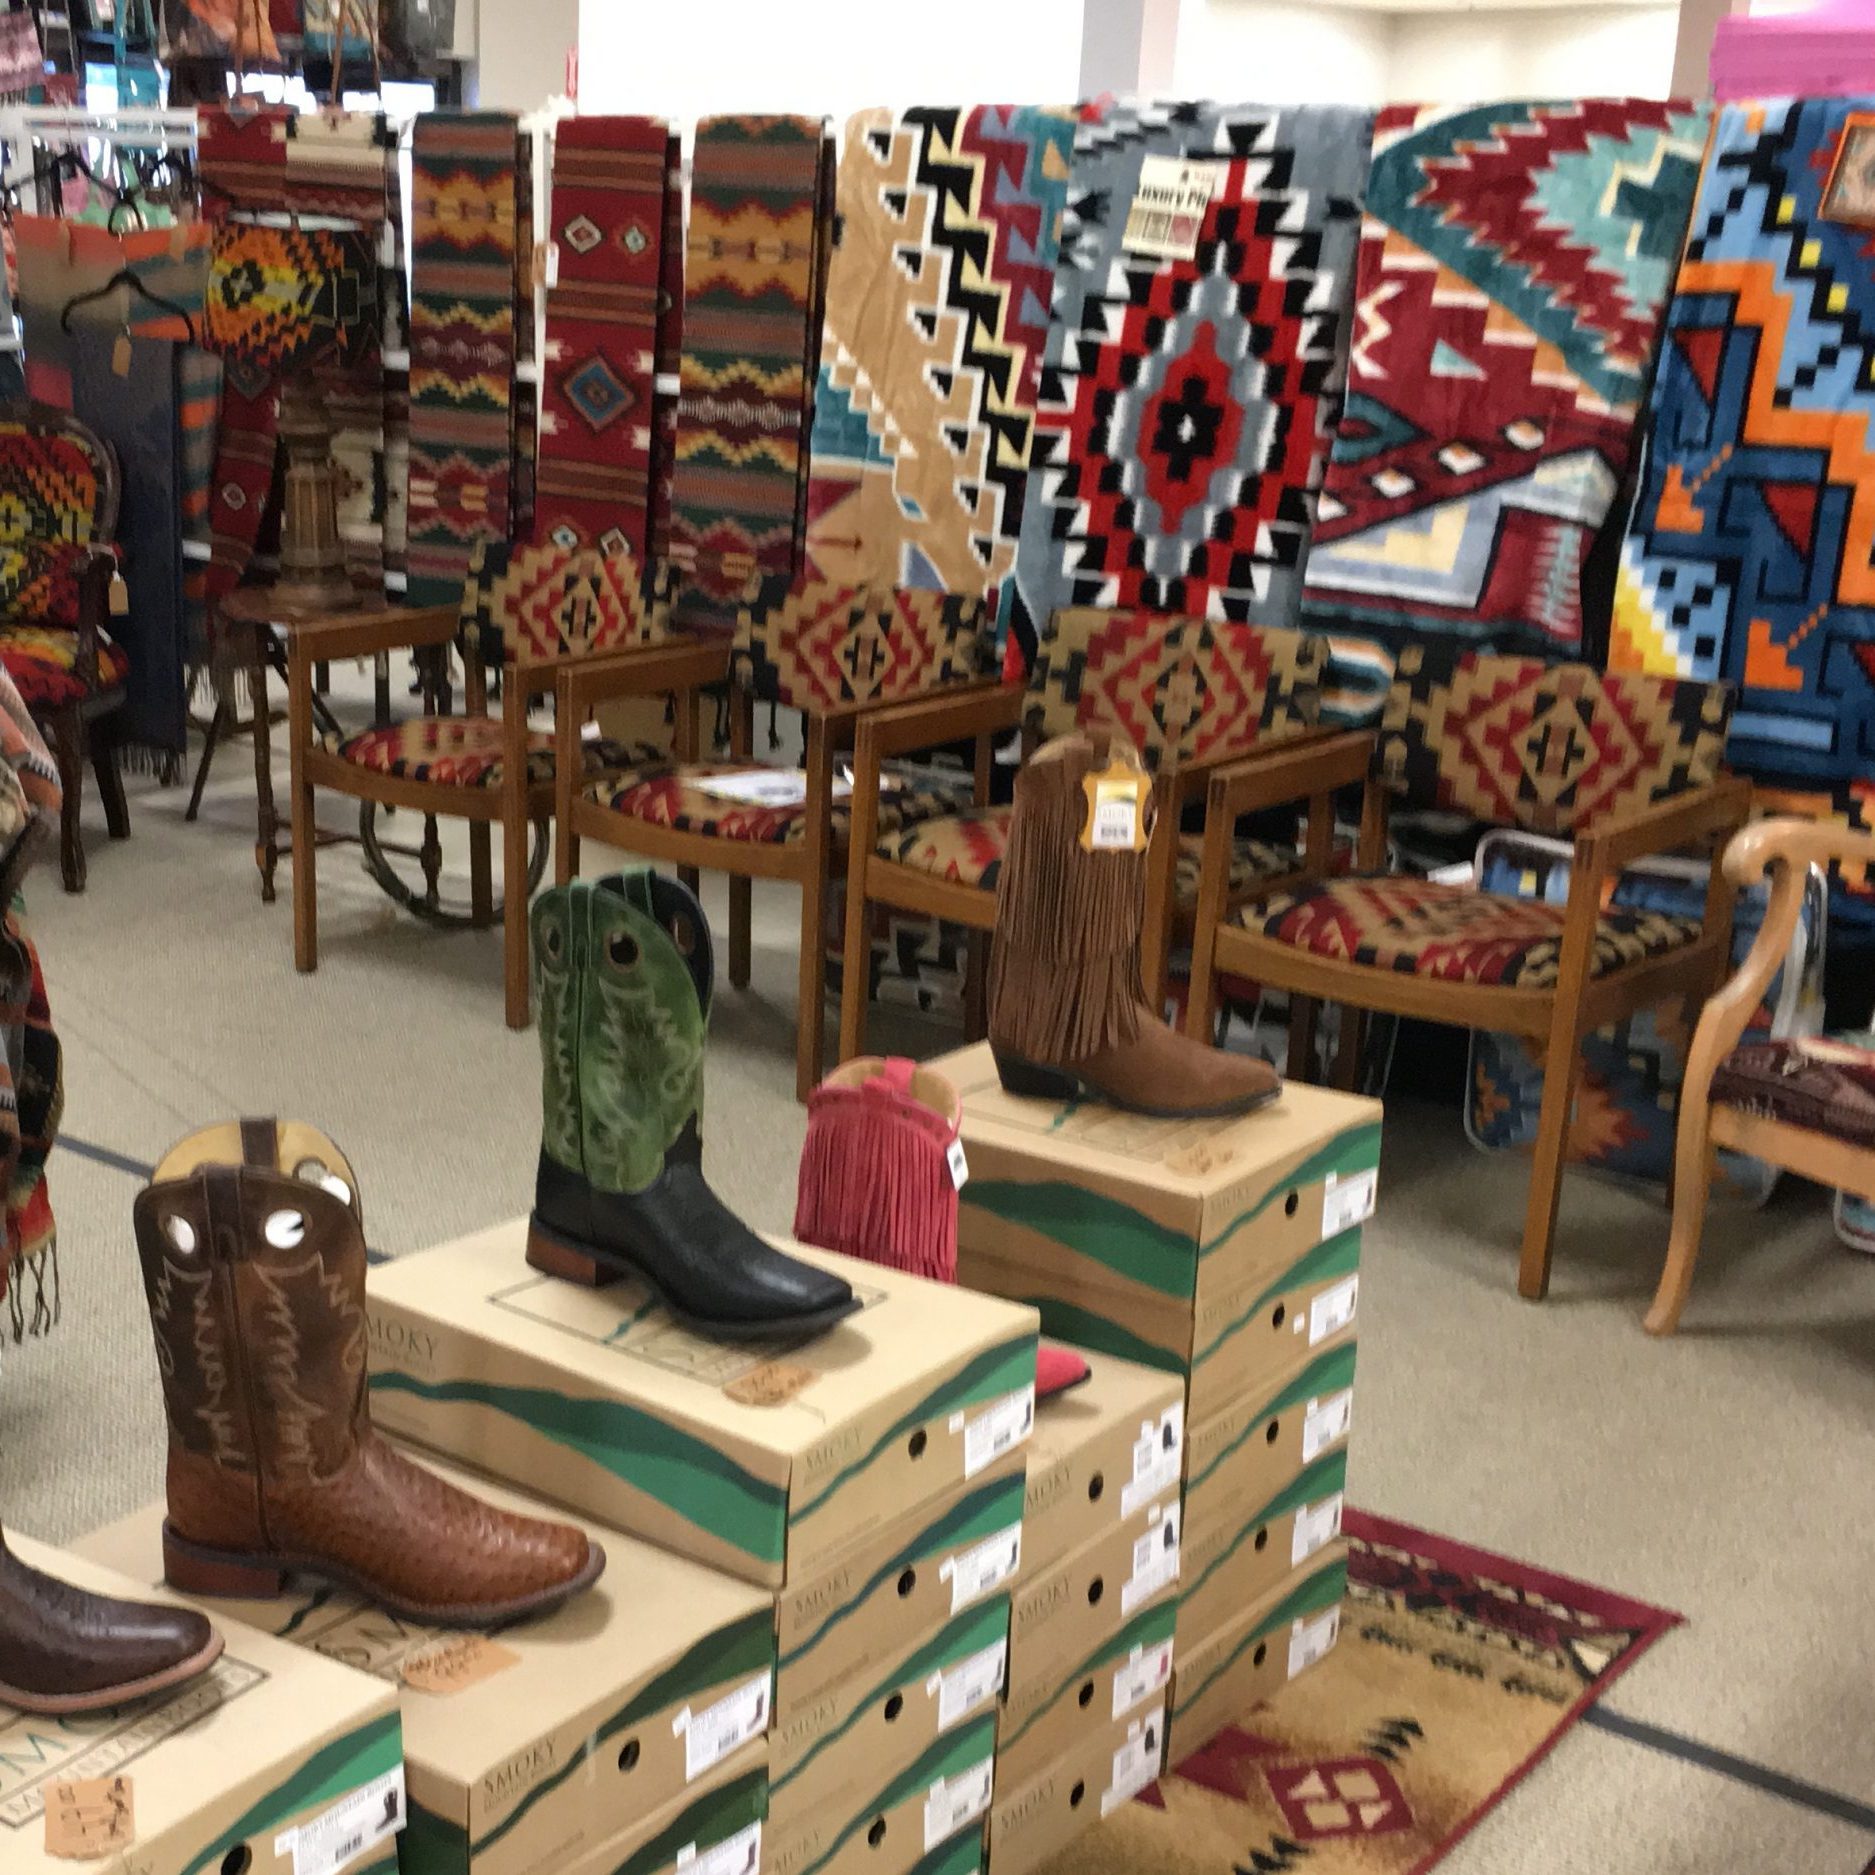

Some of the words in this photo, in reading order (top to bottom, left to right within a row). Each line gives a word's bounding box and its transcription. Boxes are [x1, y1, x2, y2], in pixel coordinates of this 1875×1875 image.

[366, 1313, 438, 1361] MOKY
[1027, 1461, 1072, 1508] MOKY
[795, 1567, 851, 1613] SMOKY
[1018, 1573, 1070, 1623] SMOKY
[484, 1736, 557, 1794] SMOKY
